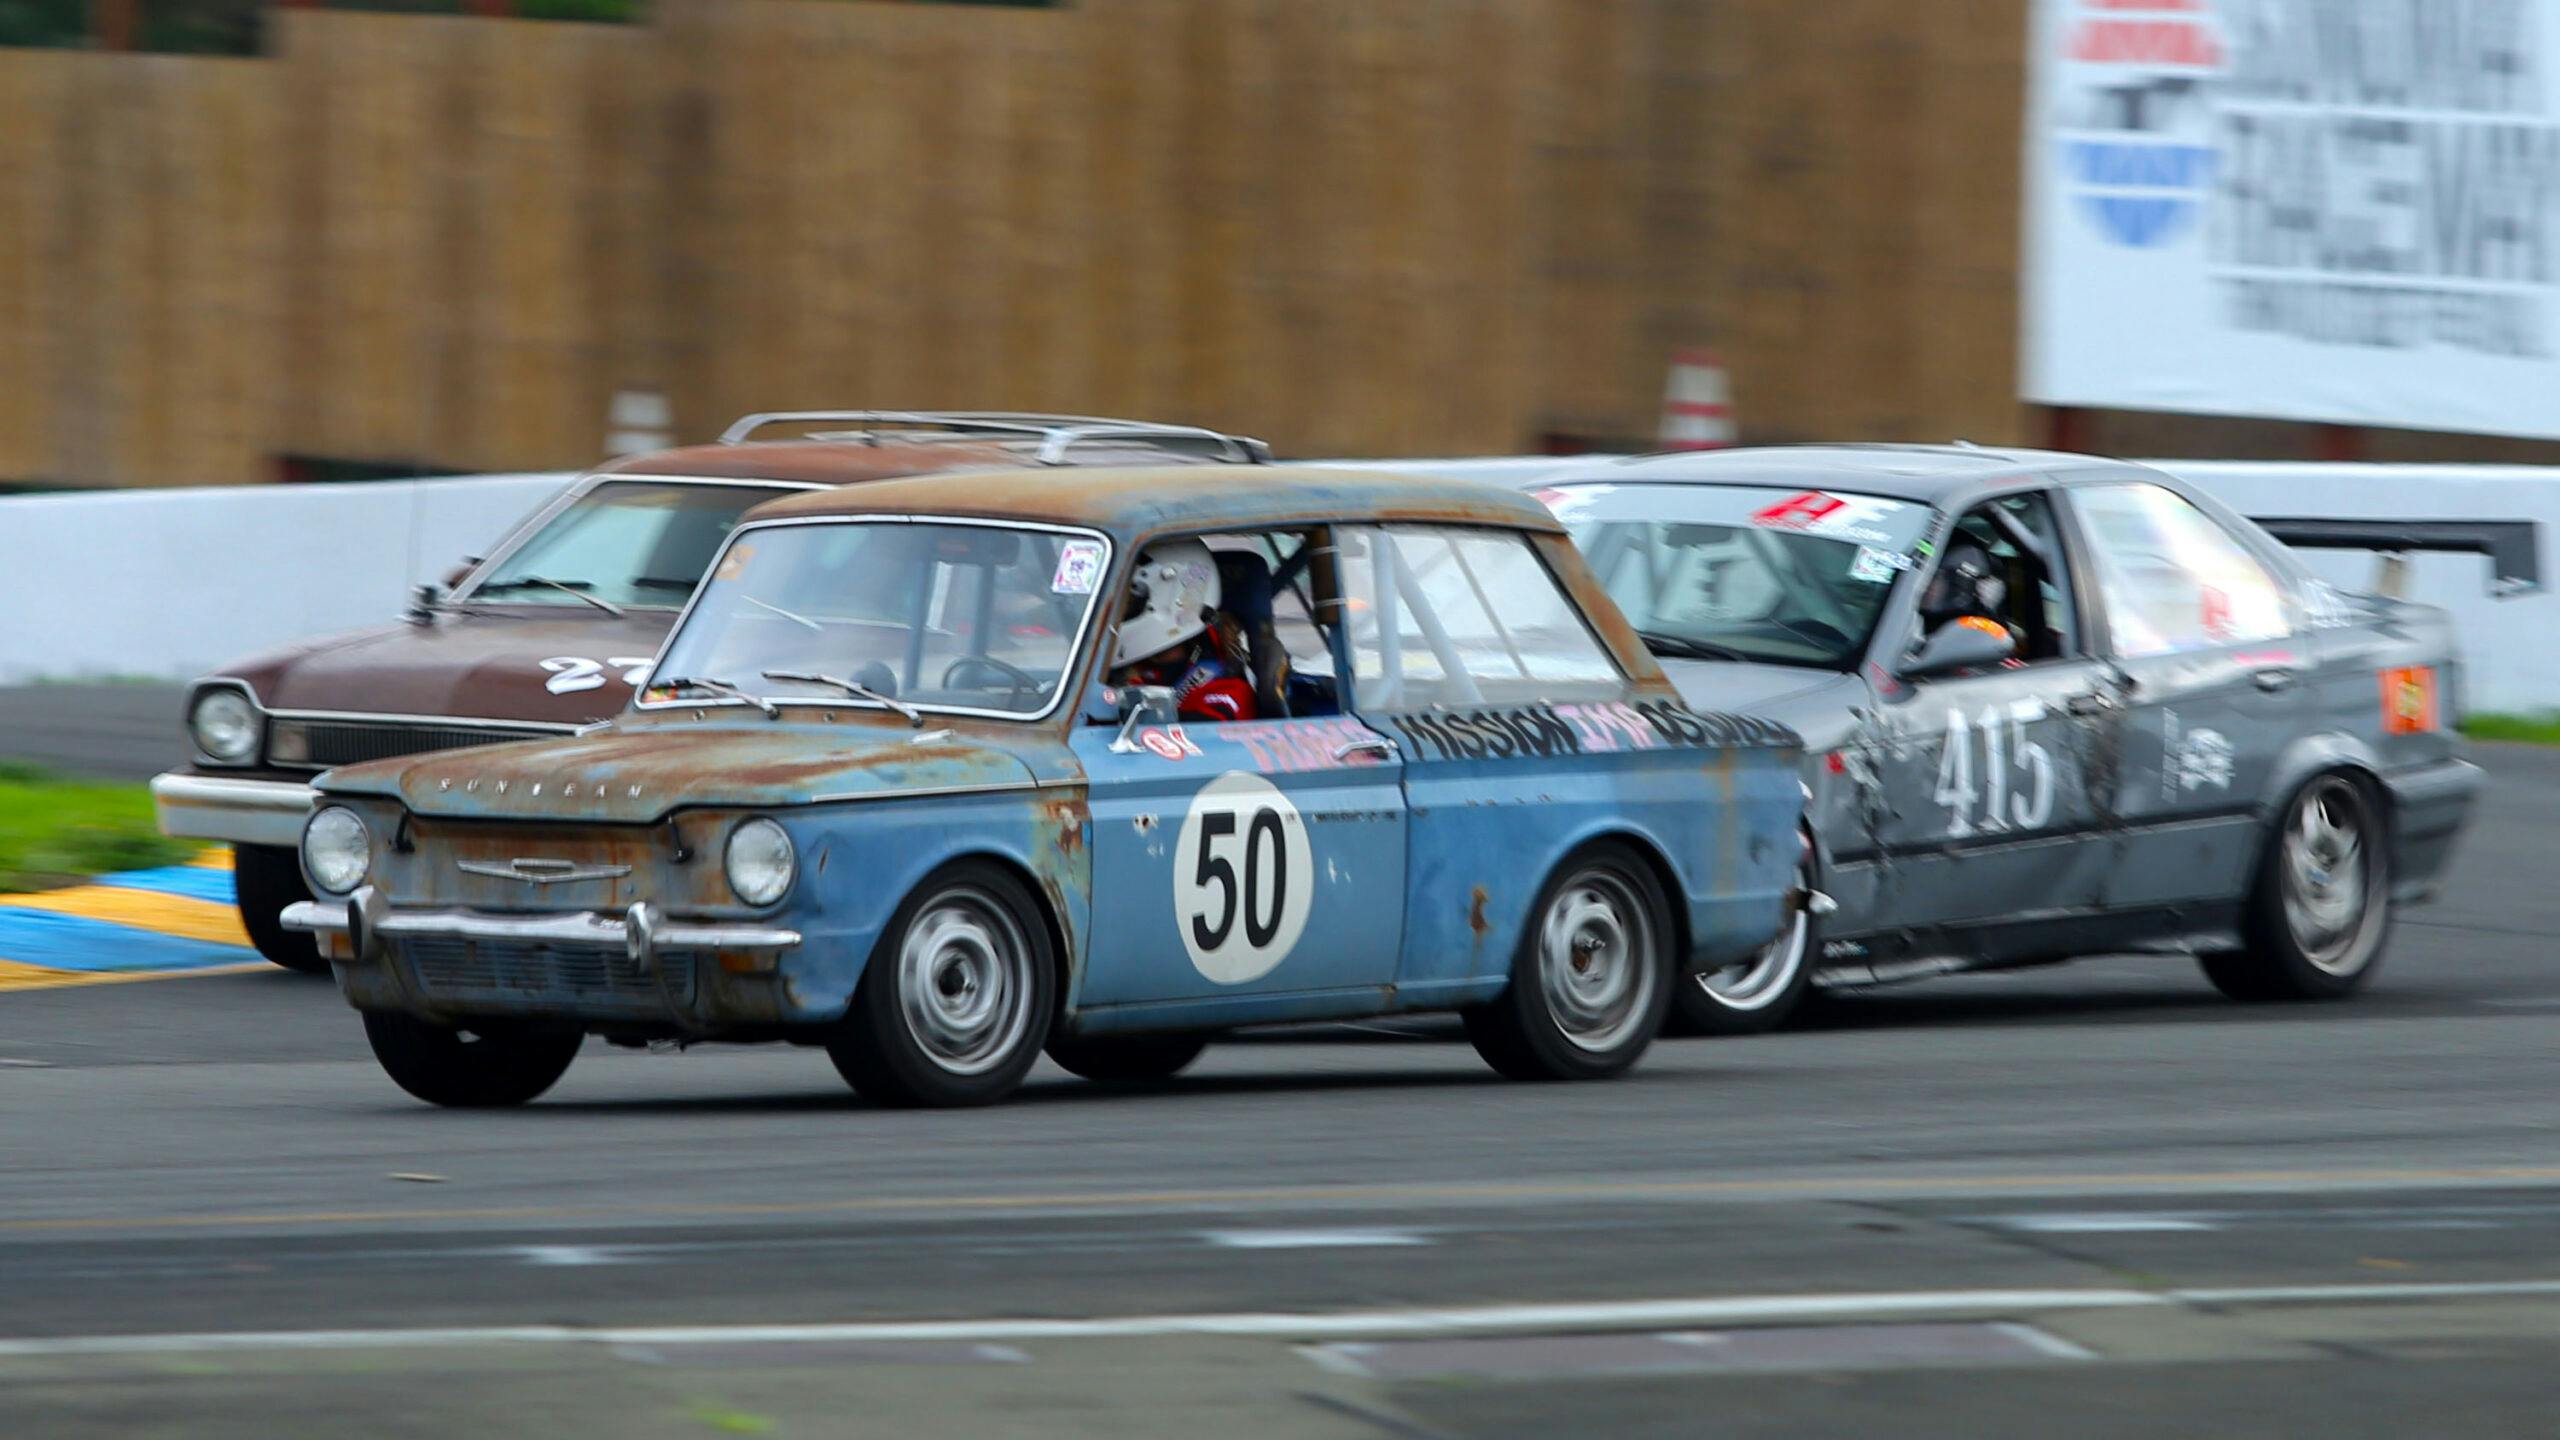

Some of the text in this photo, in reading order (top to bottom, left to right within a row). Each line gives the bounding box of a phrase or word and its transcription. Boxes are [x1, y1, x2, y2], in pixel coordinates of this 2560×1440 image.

[1392, 704, 1580, 761] MISSION
[1933, 695, 2055, 838] 415
[1192, 808, 1287, 951] 50
